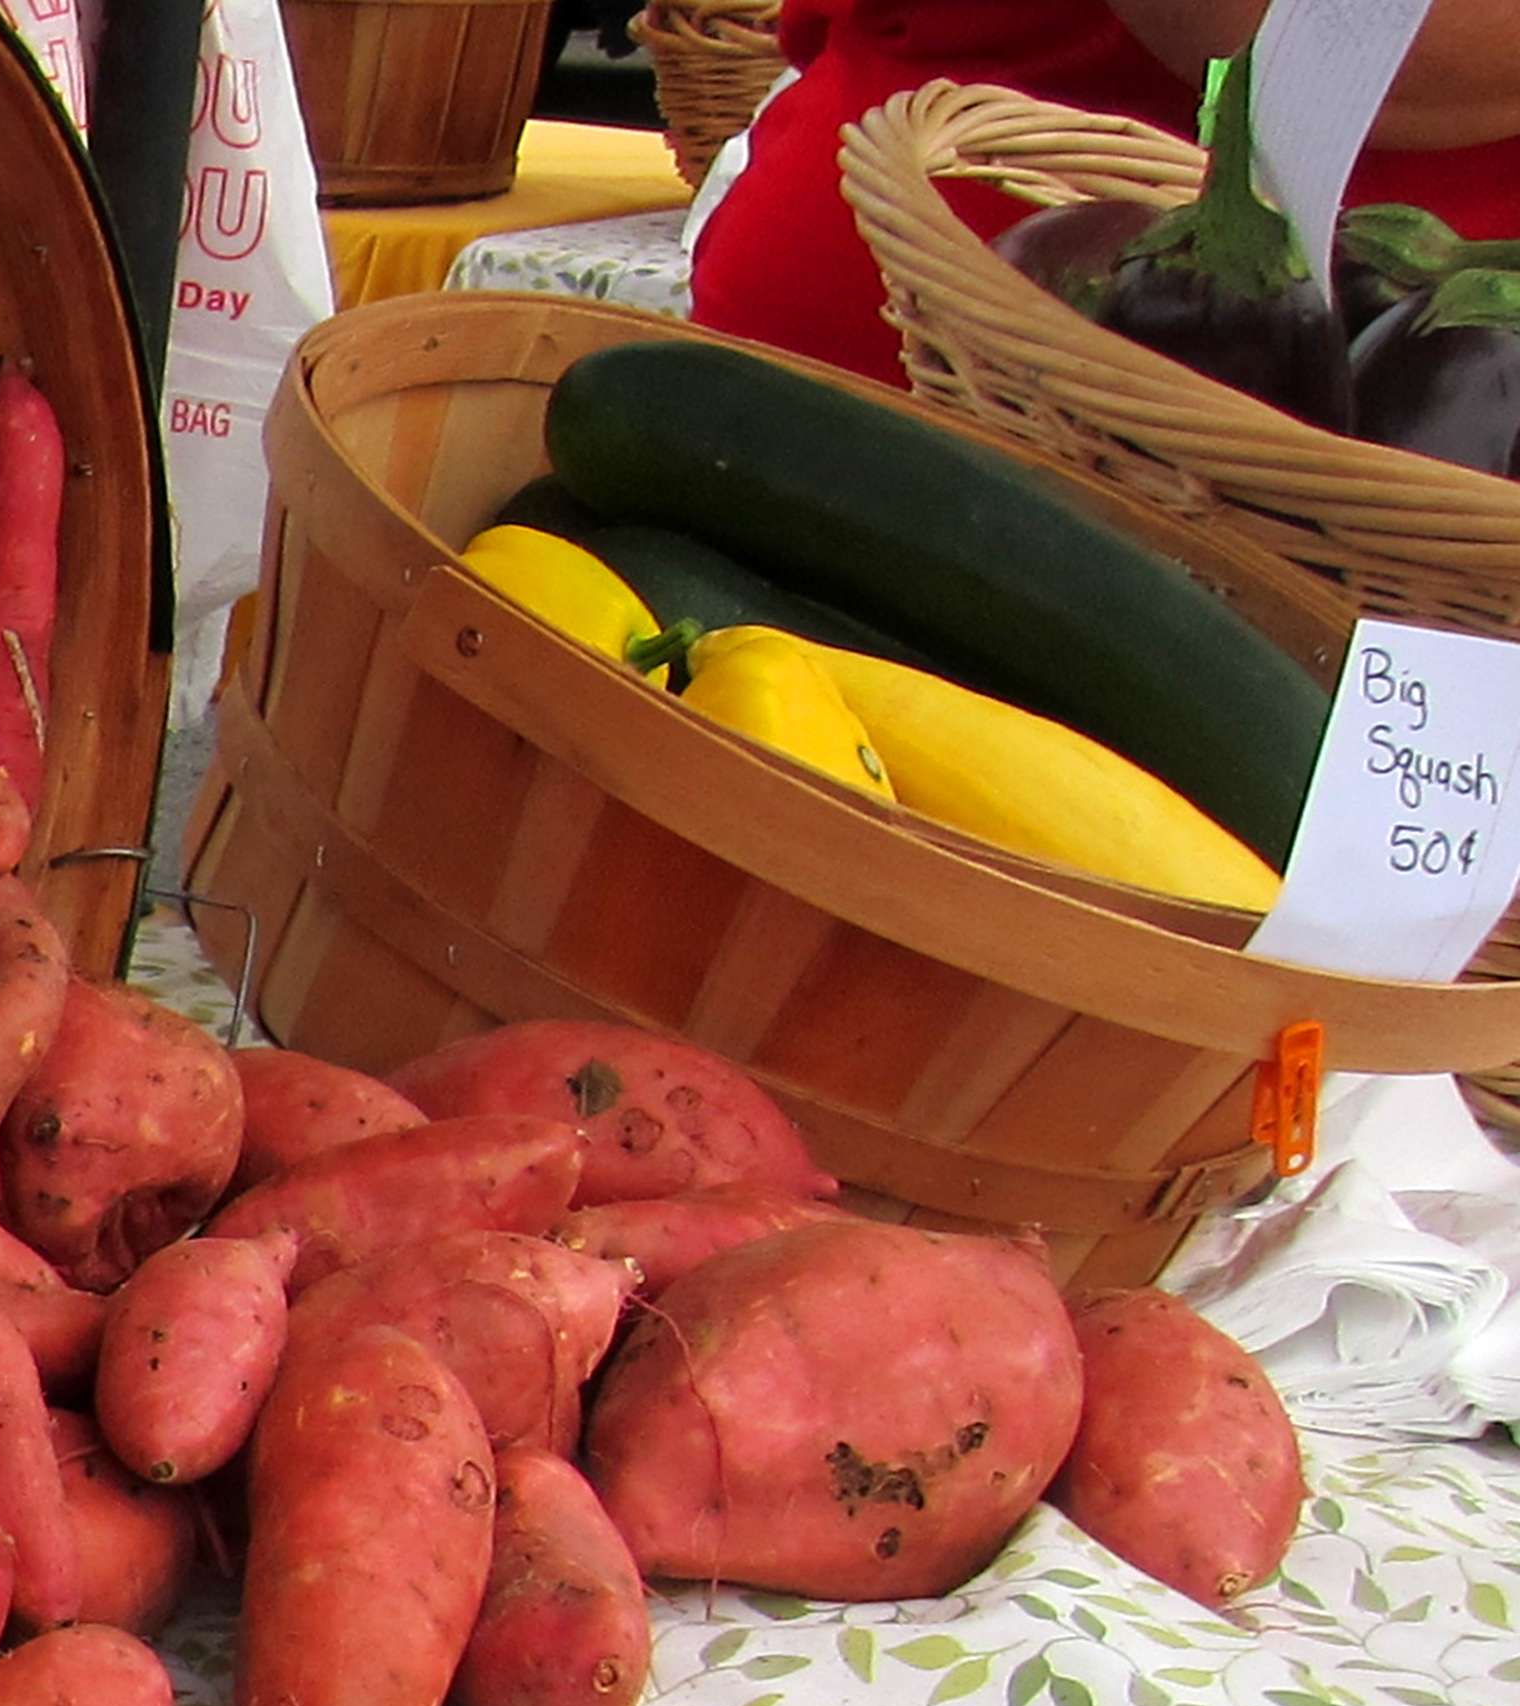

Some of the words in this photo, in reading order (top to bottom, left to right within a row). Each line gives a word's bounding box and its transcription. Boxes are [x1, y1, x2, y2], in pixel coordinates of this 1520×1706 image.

[177, 280, 251, 320] Day
[170, 399, 231, 438] BAG
[1360, 647, 1428, 730] Big
[1367, 724, 1498, 809] Squash
[1389, 823, 1478, 875] 50¢
